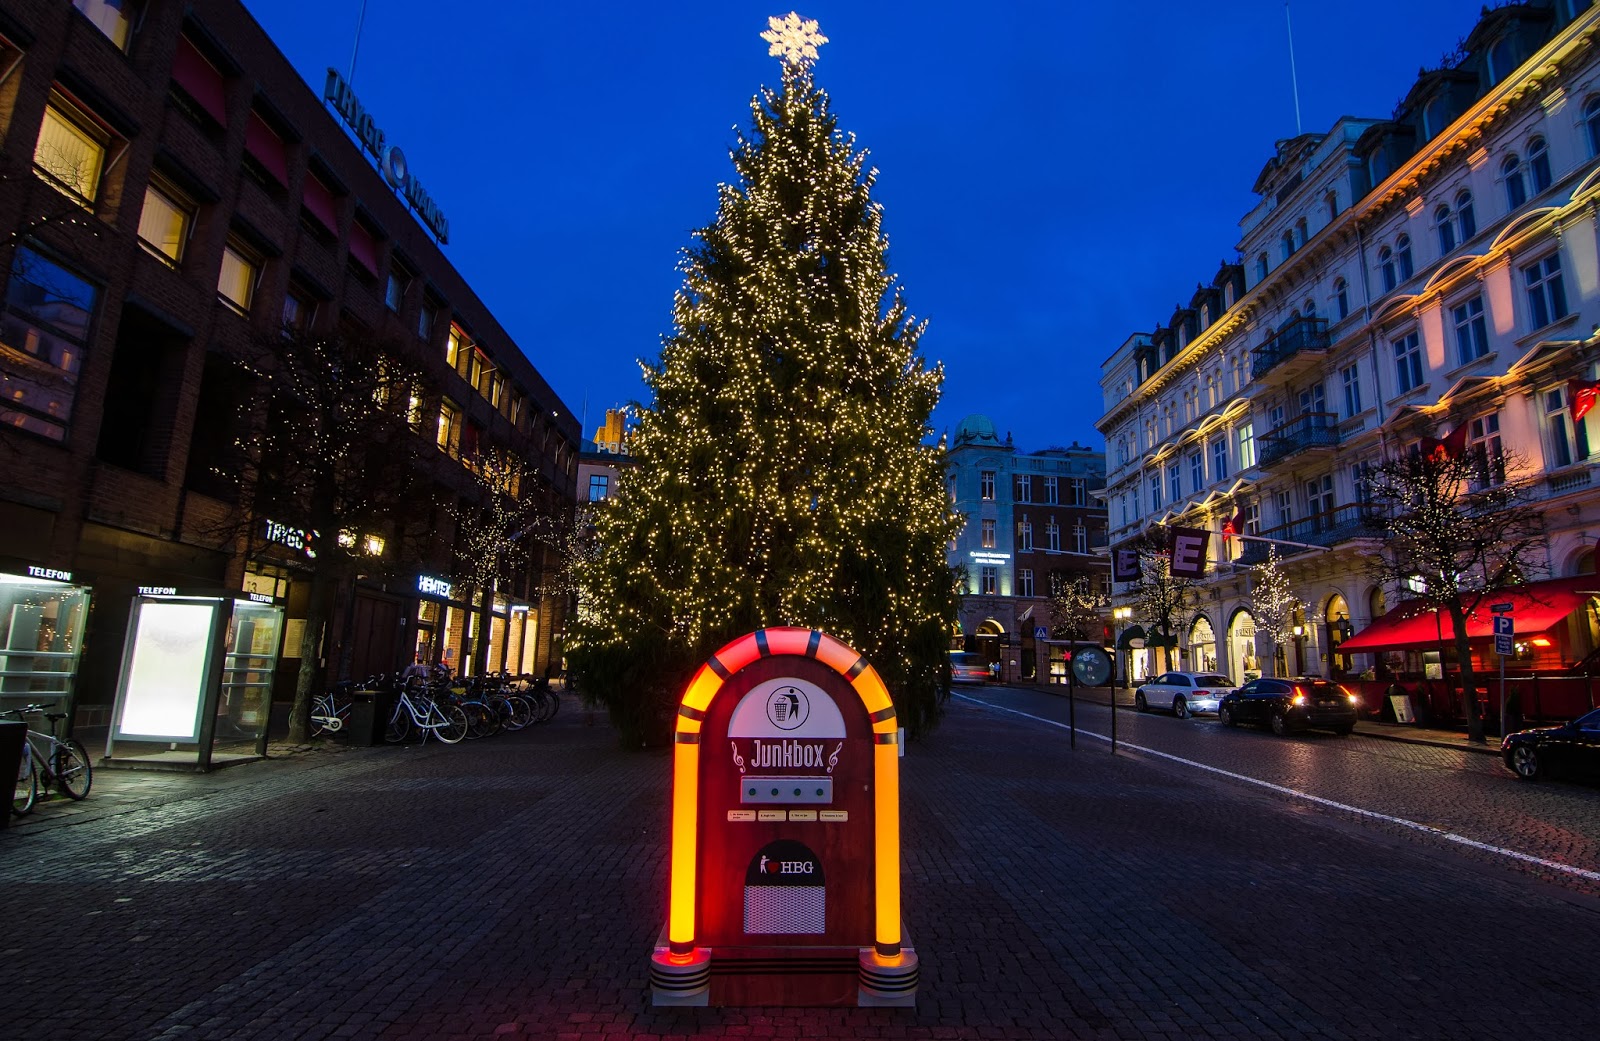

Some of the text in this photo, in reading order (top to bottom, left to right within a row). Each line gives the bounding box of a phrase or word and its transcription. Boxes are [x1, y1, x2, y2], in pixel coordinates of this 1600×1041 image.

[324, 67, 386, 158] TRYGG
[1173, 535, 1202, 571] E
[28, 565, 72, 581] TELEFON
[138, 586, 176, 595] TELEFON
[418, 575, 451, 598] HEMTEX
[250, 593, 274, 603] TELEFON
[1500, 618, 1510, 633] P
[751, 739, 824, 768] Junkbox
[780, 861, 814, 874] HBG
